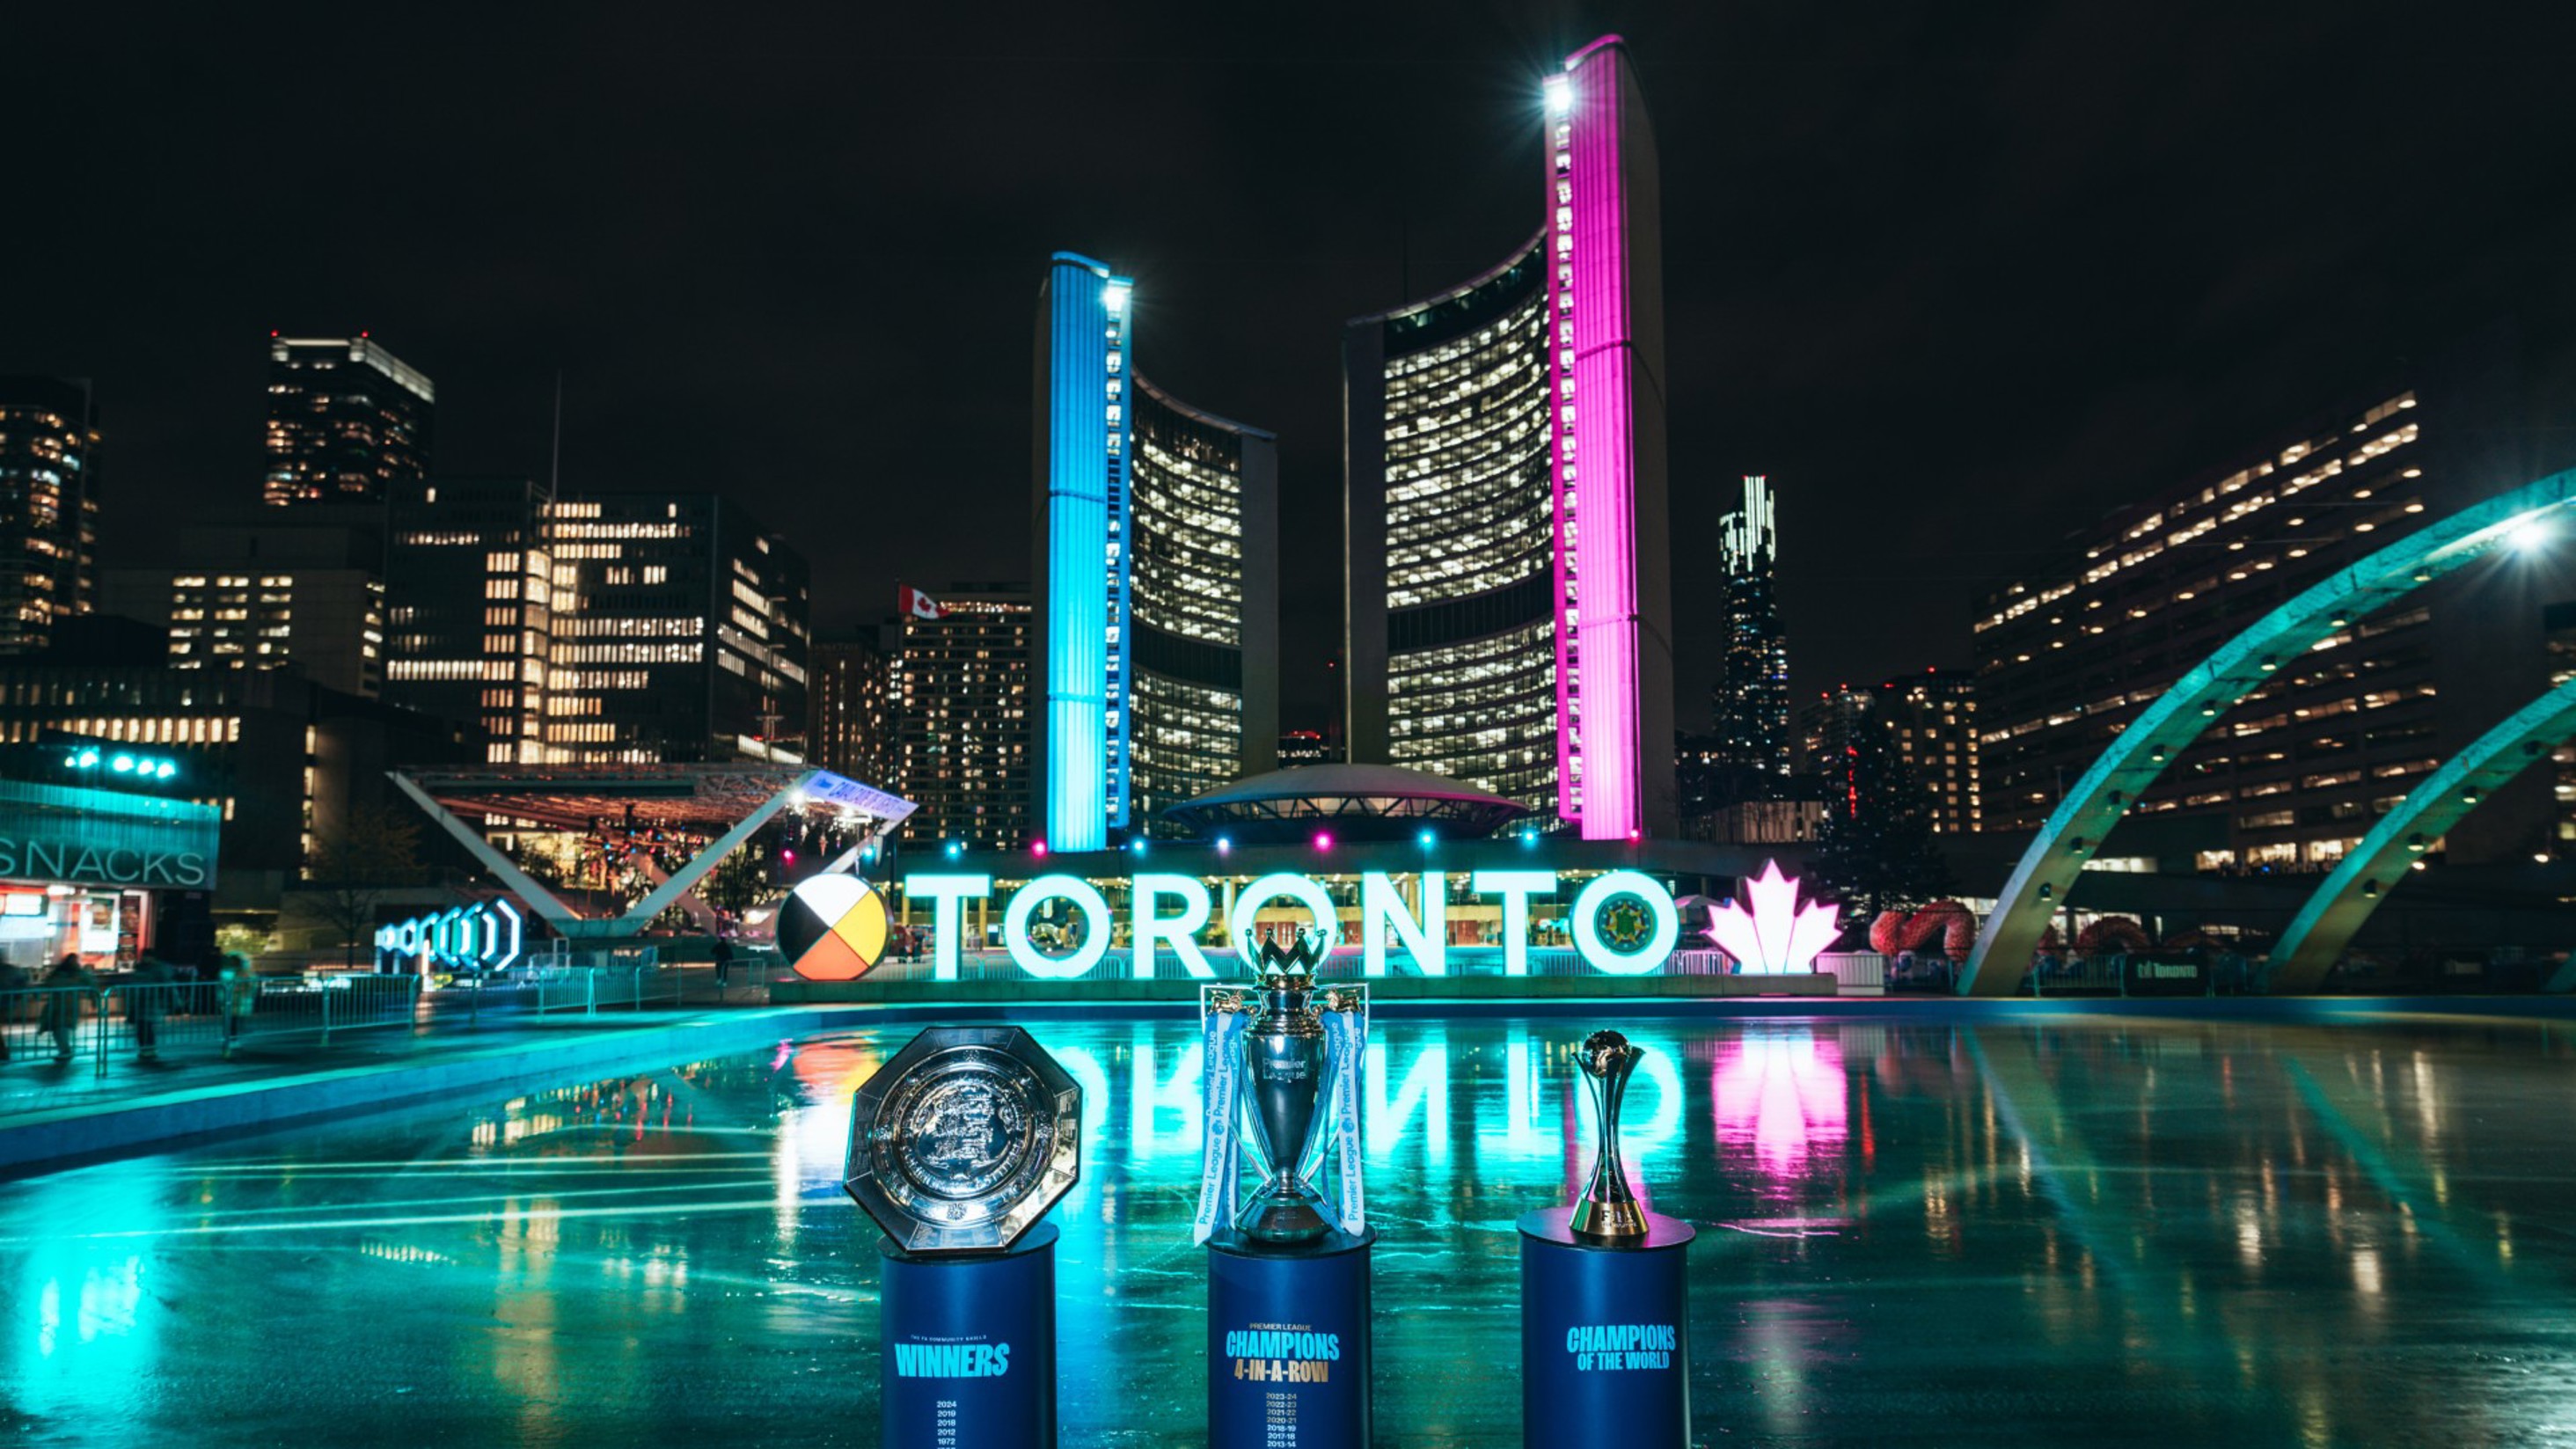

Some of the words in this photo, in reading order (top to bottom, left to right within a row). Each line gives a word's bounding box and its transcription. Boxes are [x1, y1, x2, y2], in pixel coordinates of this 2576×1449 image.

[904, 870, 1680, 981] TORONTO
[1262, 1057, 1306, 1070] Premier
[1213, 1074, 1227, 1116] Premier
[1339, 1073, 1351, 1115] Premier
[1206, 1137, 1223, 1180] League
[1346, 1136, 1358, 1178] League
[1199, 1182, 1215, 1225] Premier
[1348, 1182, 1358, 1221] Premier
[1226, 1330, 1340, 1361] CHAMPIONS
[1567, 1324, 1676, 1353] CHAMPIONS
[895, 1343, 1010, 1378] WINNERS
[1233, 1358, 1329, 1383] 4-IN-A-ROW
[1577, 1352, 1595, 1371] OF
[1597, 1351, 1623, 1371] THE
[1625, 1350, 1670, 1370] WORLD
